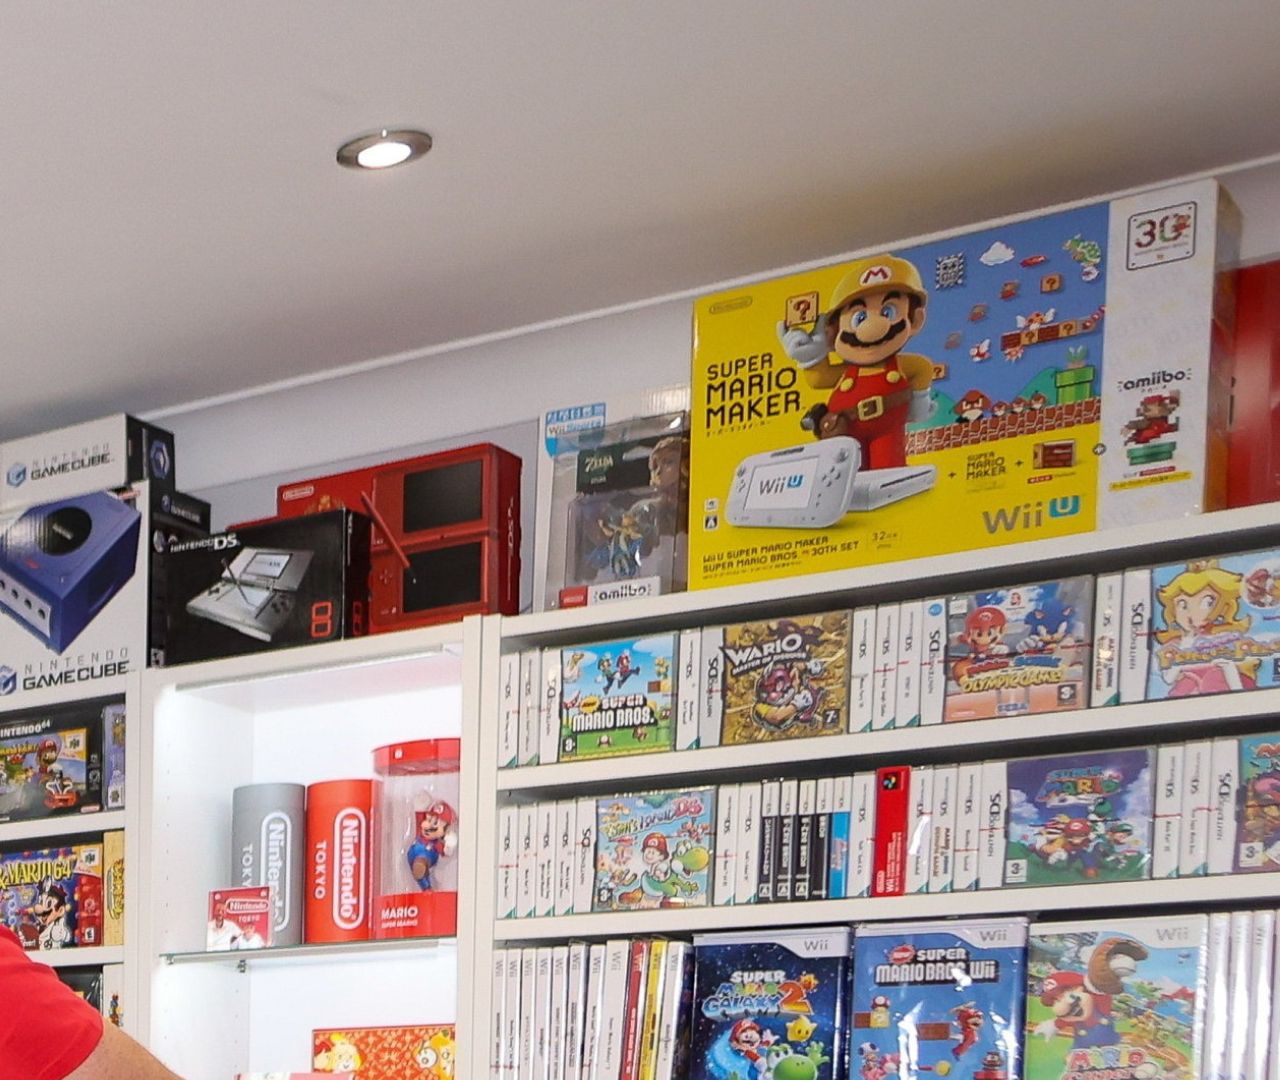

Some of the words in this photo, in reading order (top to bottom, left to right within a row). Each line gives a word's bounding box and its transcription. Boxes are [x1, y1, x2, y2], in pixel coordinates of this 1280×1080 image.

[707, 352, 773, 381] SUPER
[707, 367, 797, 405] MARIO
[1123, 369, 1186, 391] amiibo
[705, 391, 801, 429] MAKER
[31, 452, 111, 481] GAMECUBE
[759, 478, 785, 496] Wii
[982, 502, 1043, 534] Wii
[1049, 495, 1080, 518] U
[214, 533, 238, 551] DS
[727, 547, 758, 560] SUPER
[760, 542, 791, 554] MARIO
[795, 536, 828, 548] MAKER
[703, 562, 735, 574] SUPER
[737, 557, 768, 568] MARIO
[841, 541, 859, 551] SET
[599, 585, 647, 602] amiibo
[24, 648, 129, 676] NINTENDO
[722, 633, 802, 666] WARIO
[23, 661, 130, 691] GAMECUBE
[572, 709, 614, 732] MARIO
[315, 841, 327, 899] TOKYO
[341, 818, 358, 918] Nintendo
[229, 901, 268, 911] Nintendo
[381, 906, 418, 920] MARIO
[803, 938, 829, 951] Wii
[980, 929, 1008, 942] Wii
[916, 947, 967, 961] SUPER
[730, 970, 786, 984] SUPER
[875, 962, 923, 984] MARIO
[969, 959, 997, 980] Wii
[778, 981, 815, 1016] 2
